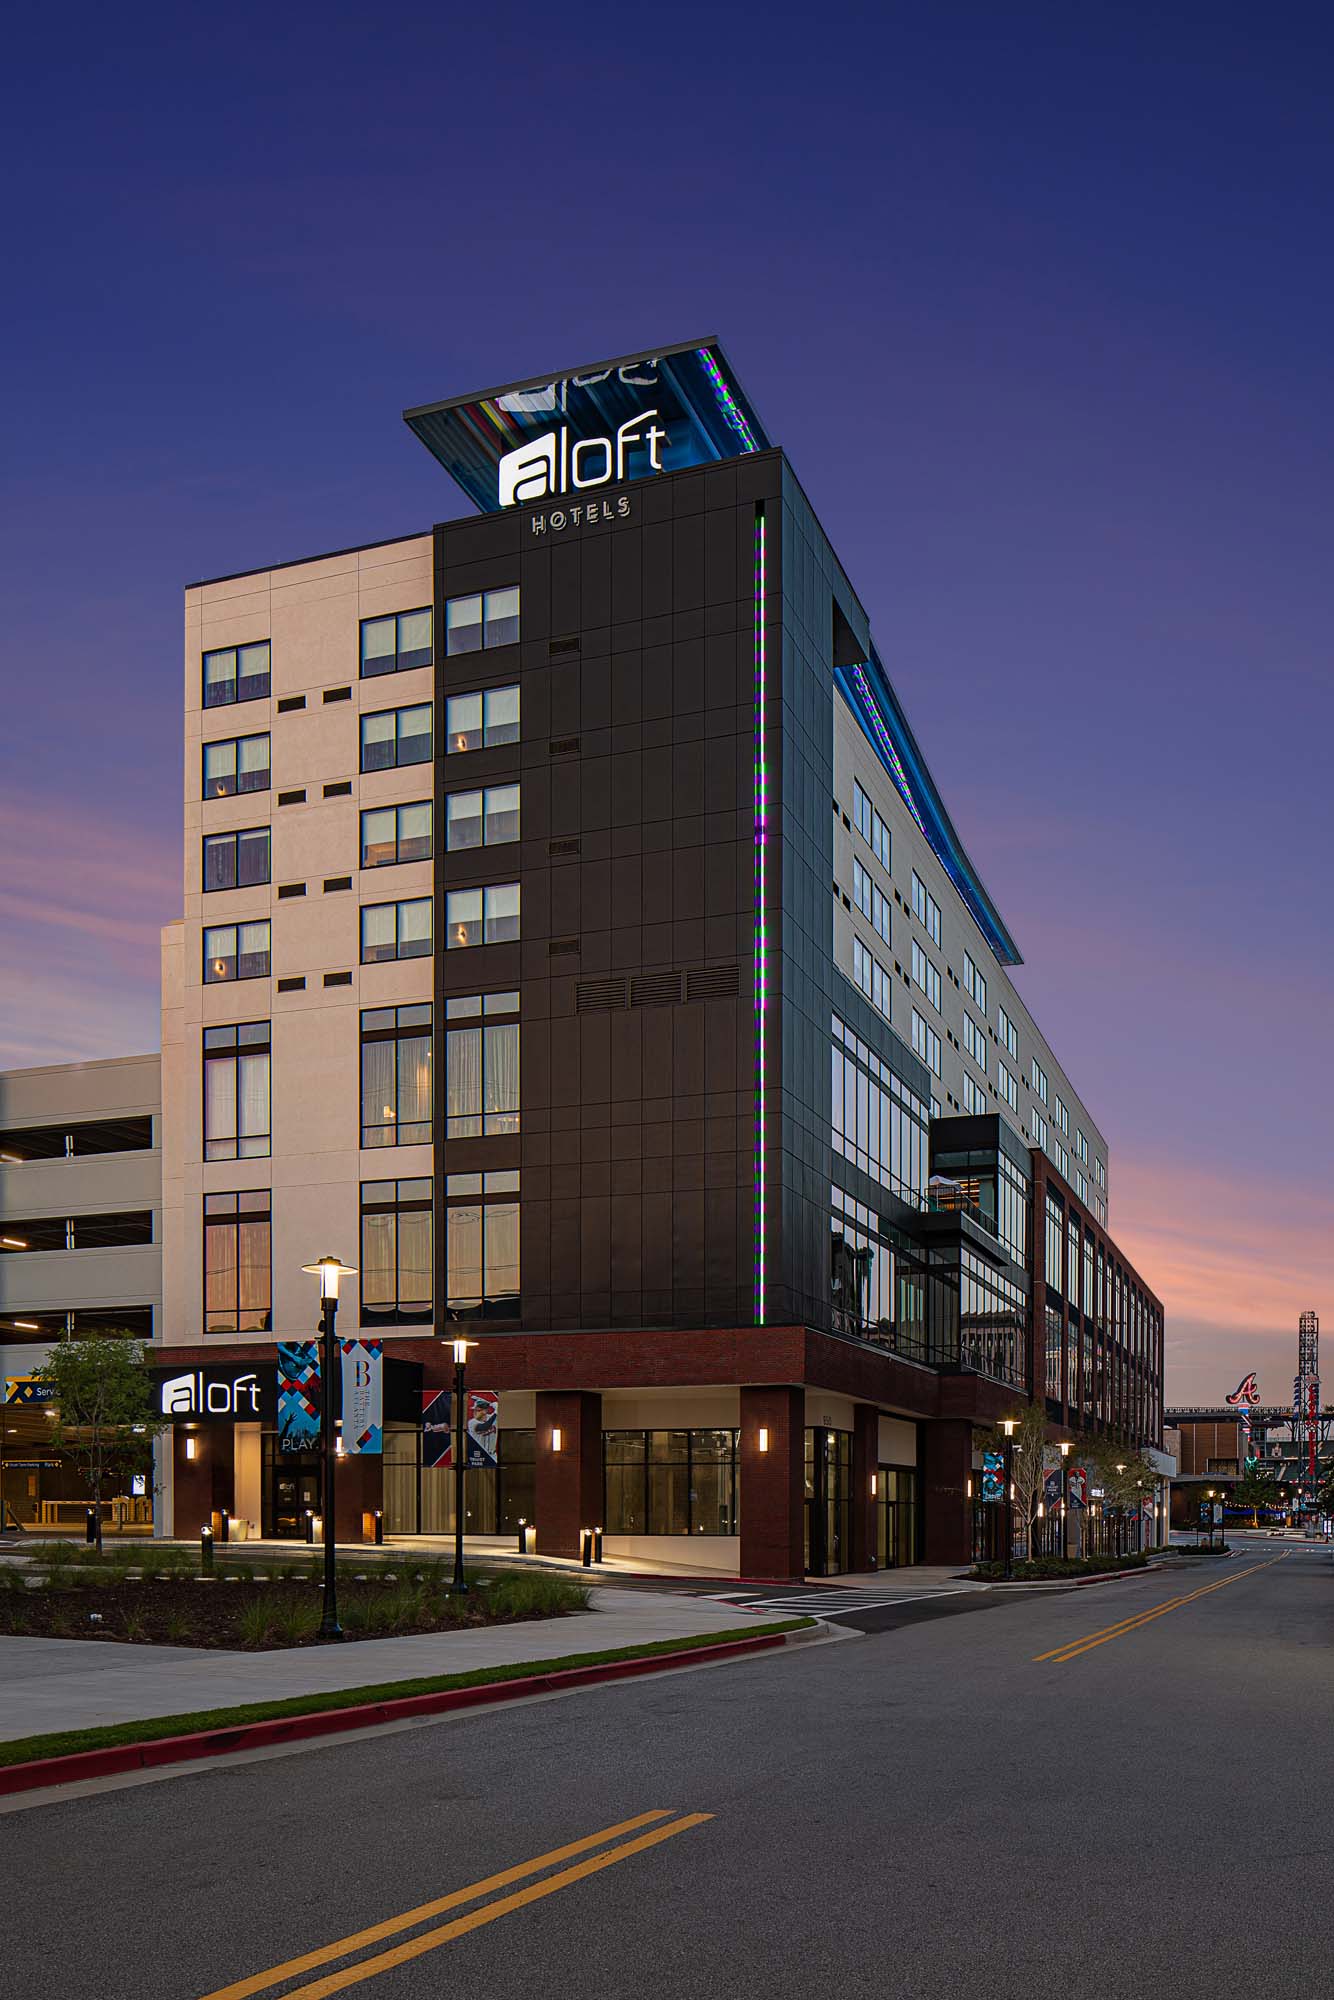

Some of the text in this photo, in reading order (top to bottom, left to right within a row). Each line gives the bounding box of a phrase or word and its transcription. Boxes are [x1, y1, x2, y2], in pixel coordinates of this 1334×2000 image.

[499, 409, 666, 506] aloft
[531, 497, 631, 535] HOTELS
[161, 1371, 261, 1415] aloft
[352, 1360, 371, 1388] B
